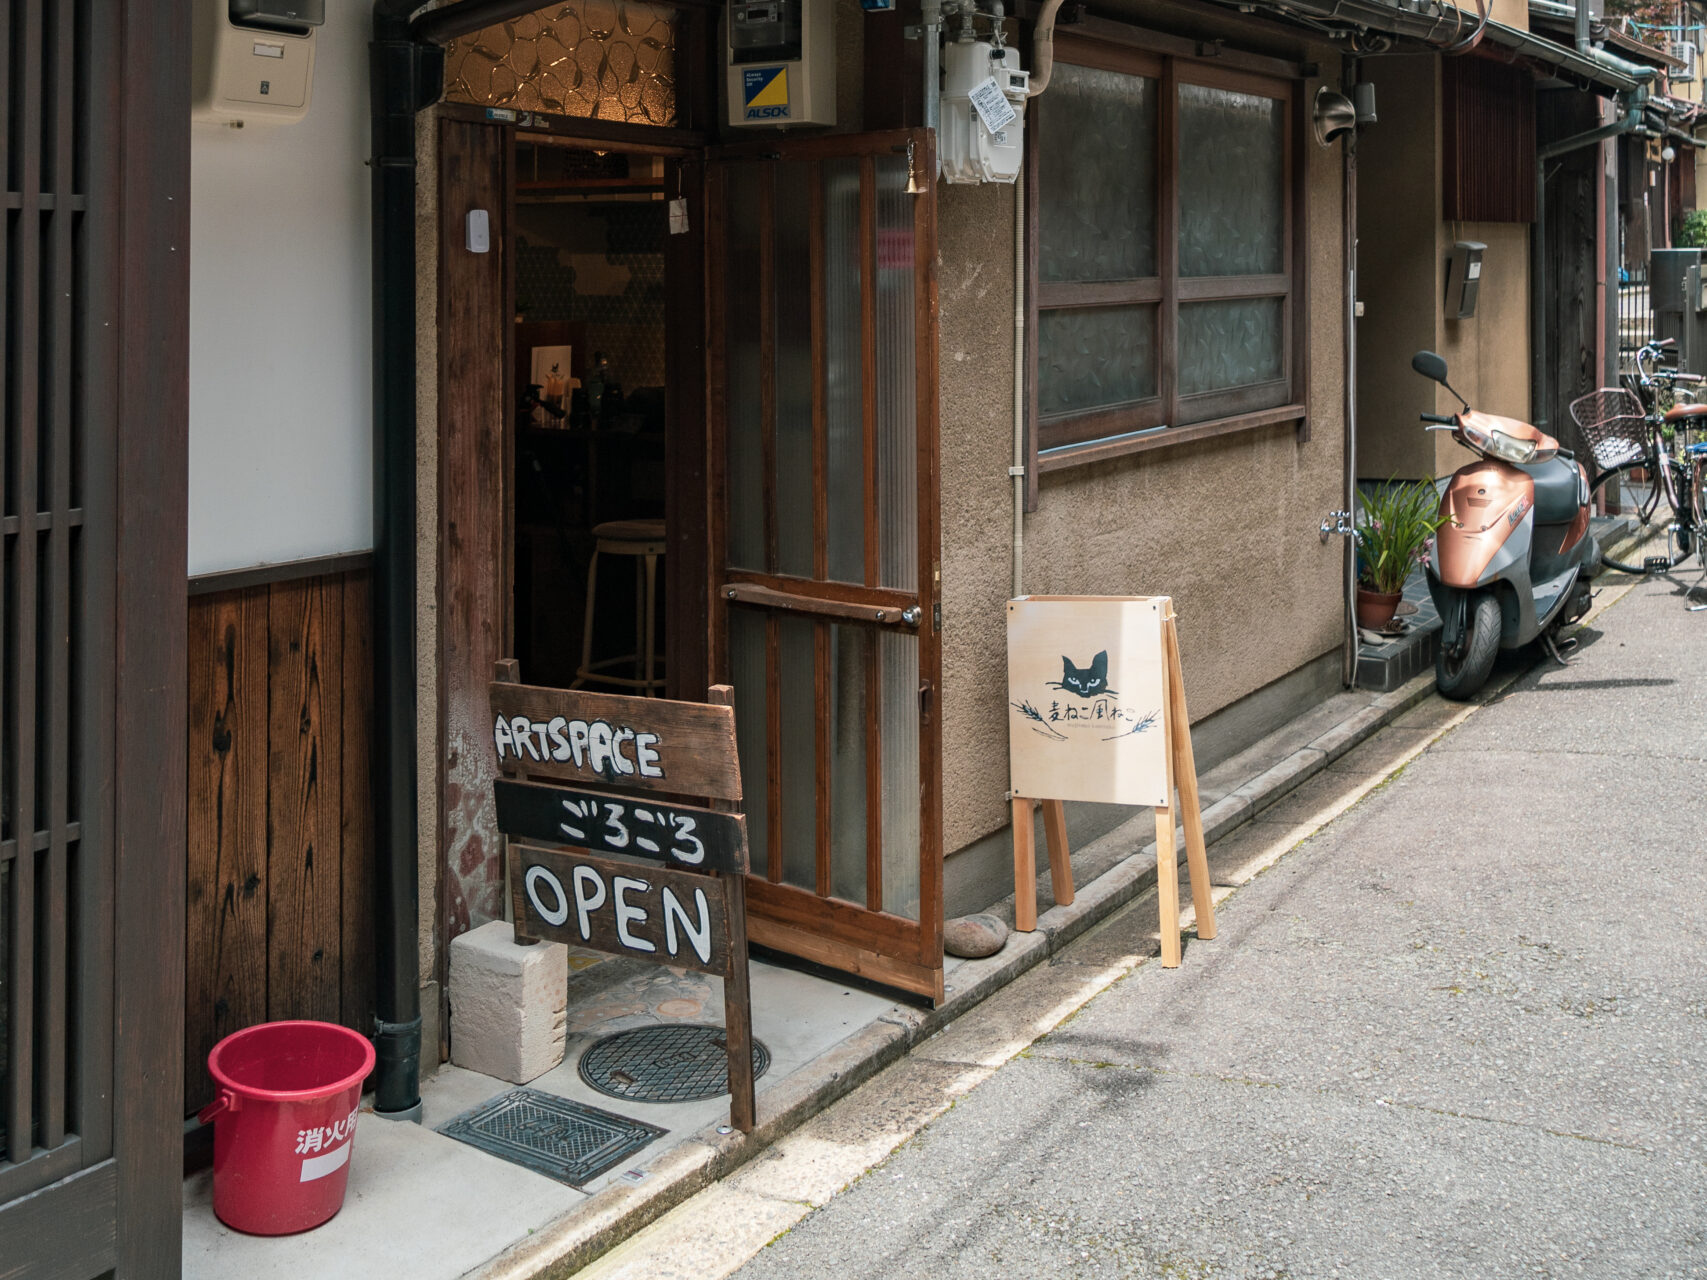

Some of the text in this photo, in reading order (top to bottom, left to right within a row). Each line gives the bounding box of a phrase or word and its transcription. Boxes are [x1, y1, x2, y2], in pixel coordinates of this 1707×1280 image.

[747, 106, 789, 119] ALSOK
[493, 711, 666, 780] ARTSPACE
[559, 798, 706, 865] ごろごろ
[524, 863, 713, 966] OPEN
